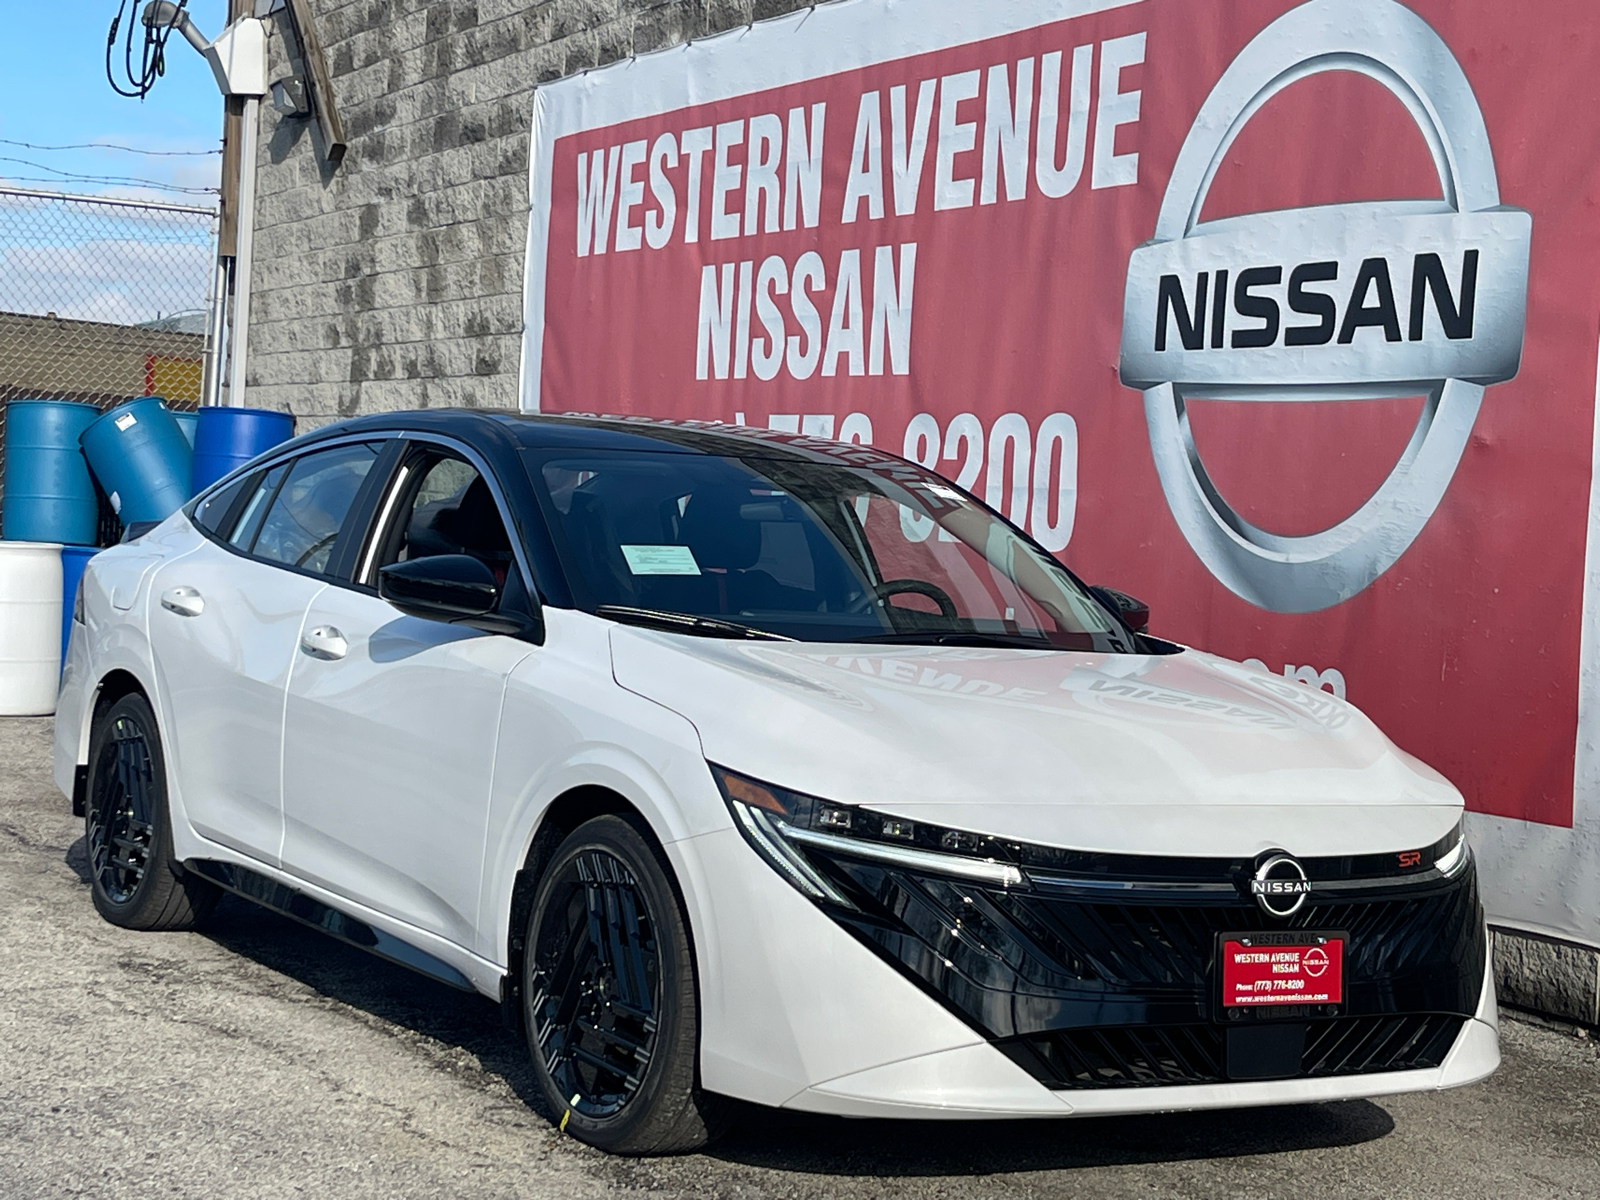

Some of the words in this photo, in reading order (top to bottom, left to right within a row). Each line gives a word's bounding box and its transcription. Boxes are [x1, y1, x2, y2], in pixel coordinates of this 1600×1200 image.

[576, 102, 826, 258] WESTERN
[841, 31, 1147, 223] AVENUE
[1154, 249, 1480, 352] NISSAN
[696, 242, 917, 381] NISSAN
[1398, 851, 1421, 867] SR
[1253, 881, 1312, 893] NISSAN
[1250, 933, 1295, 945] WESTERN
[1234, 953, 1270, 964] WESTERN
[1270, 952, 1300, 963] AVENUE
[1272, 963, 1300, 973] NISSAN
[1254, 980, 1272, 992] (773)
[1273, 980, 1305, 990] 776-8200
